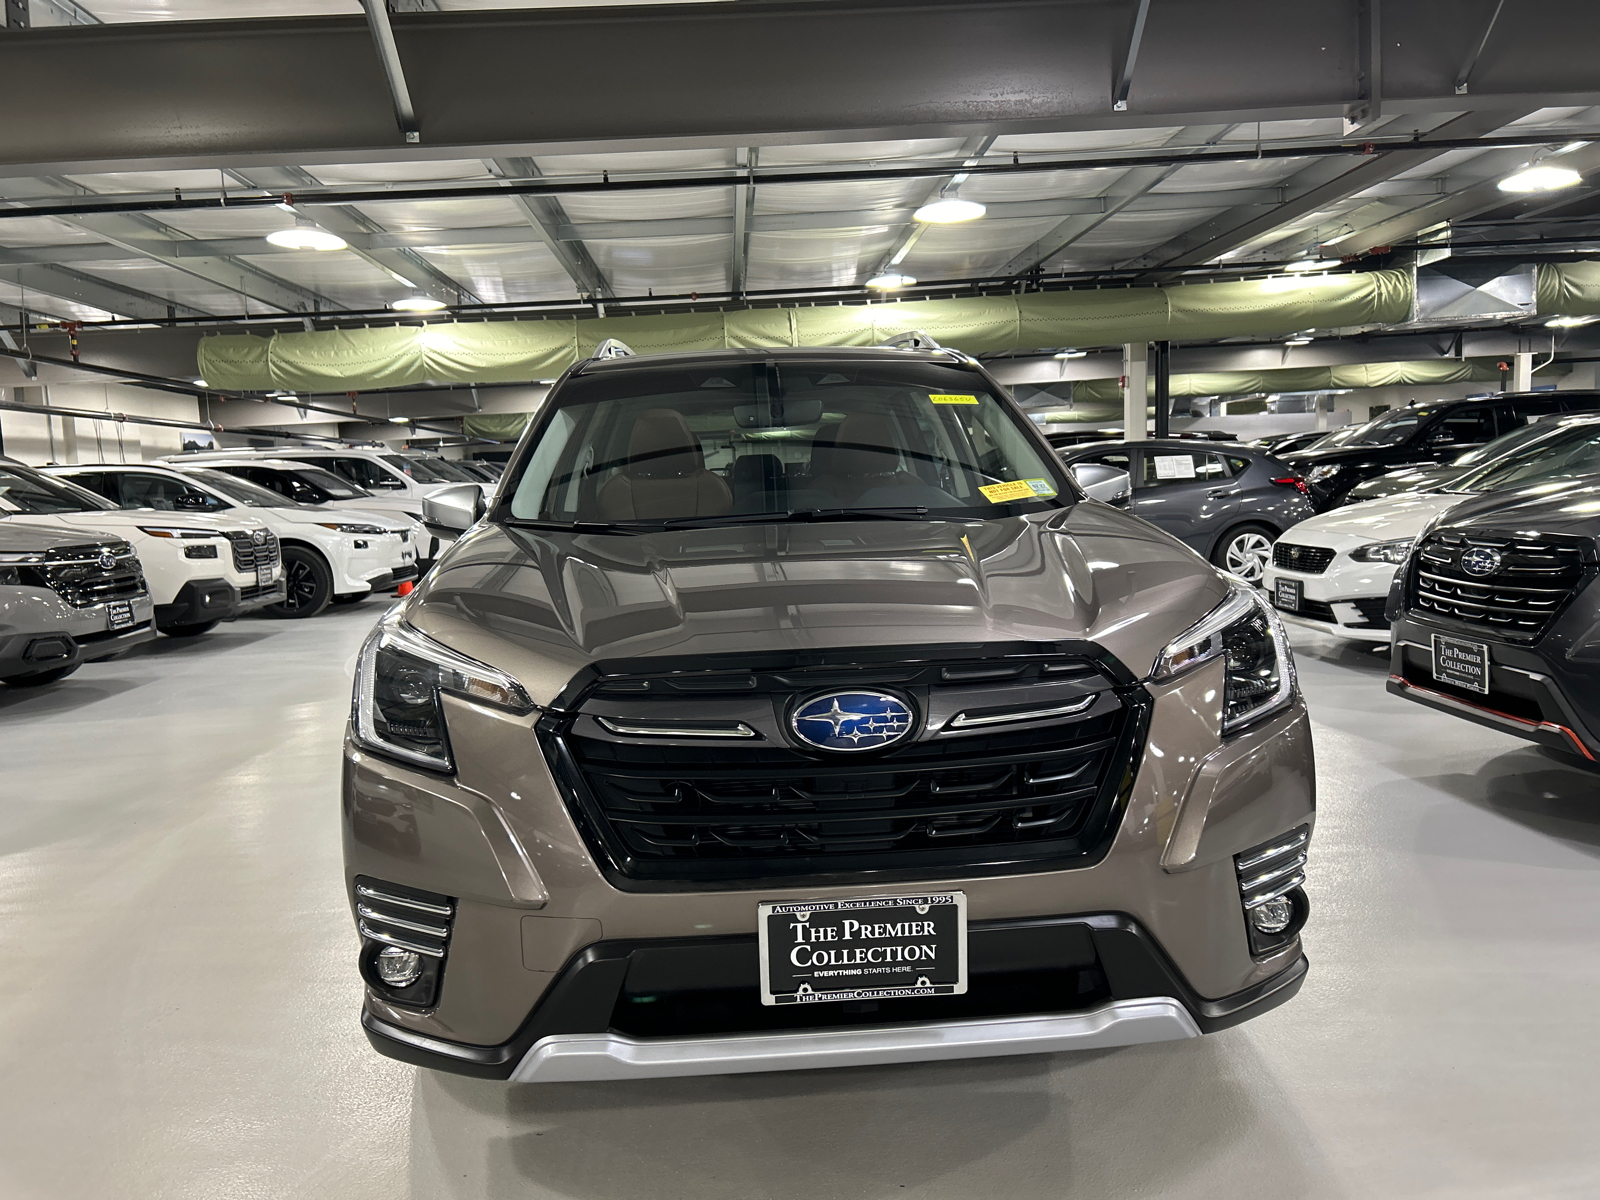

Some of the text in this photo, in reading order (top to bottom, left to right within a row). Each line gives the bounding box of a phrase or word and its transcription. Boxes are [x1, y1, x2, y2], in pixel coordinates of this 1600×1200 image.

[1440, 645, 1481, 664] THE PREMIER
[1440, 655, 1481, 676] COLLECTION
[774, 895, 952, 913] AUTOMOTIVE EXCELLENCE SINCE 1995
[790, 919, 937, 944] THE PREMIER
[790, 944, 937, 968] COLLECTION
[814, 969, 862, 978] EVERYTHING
[863, 967, 891, 975] STARTS
[794, 987, 935, 1003] THEPREMIERCOLLECTION.COM
